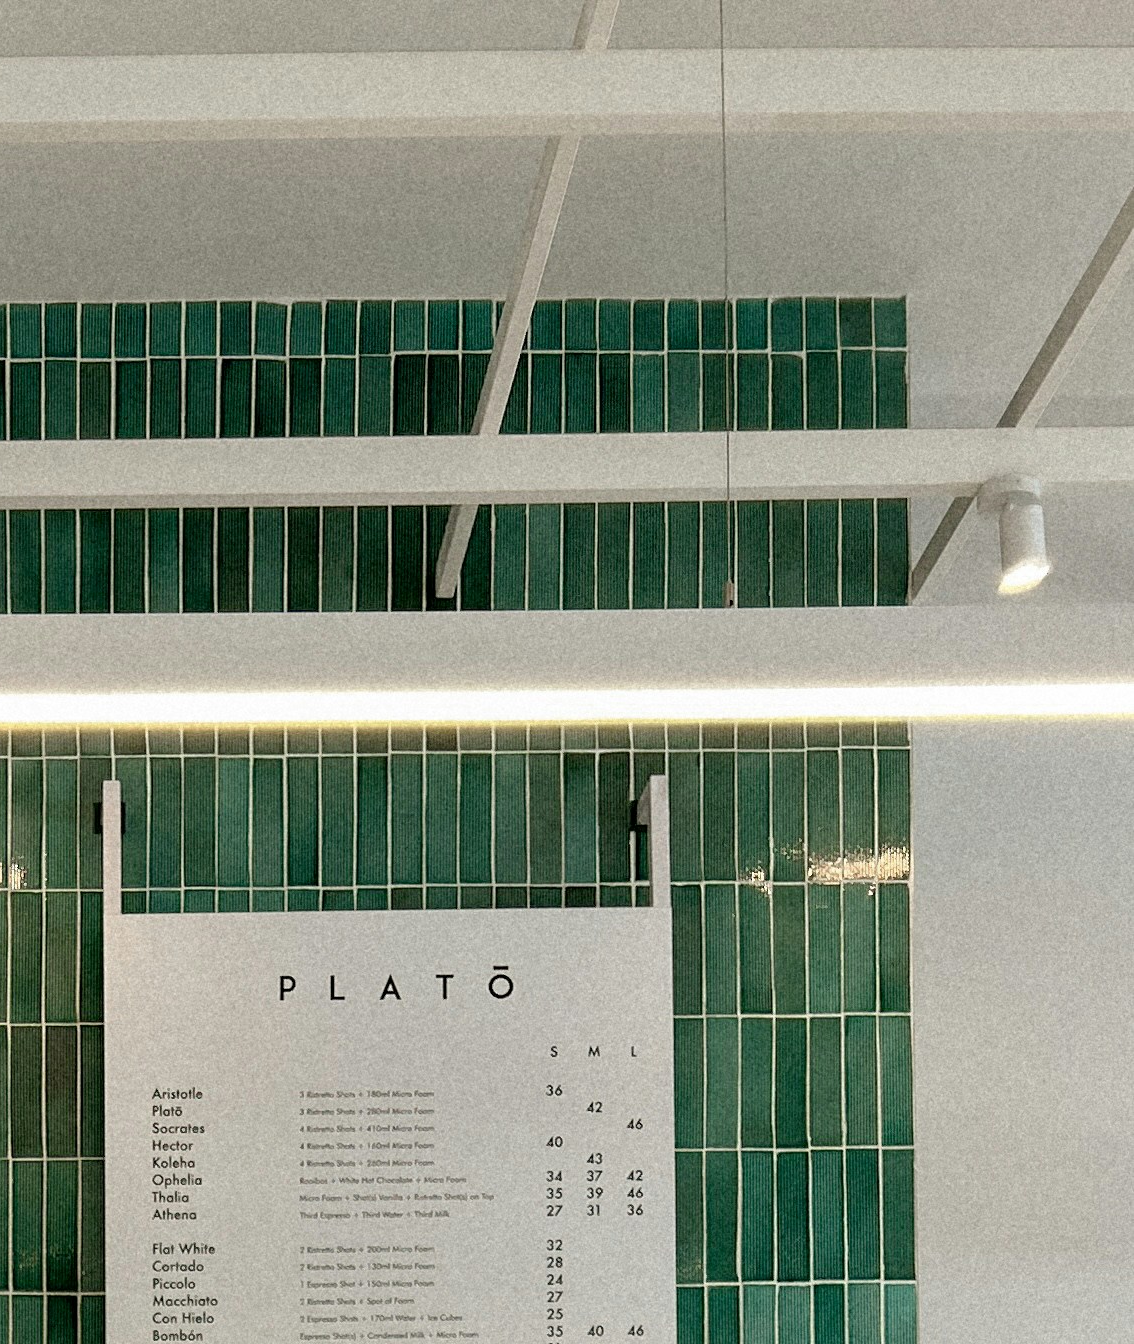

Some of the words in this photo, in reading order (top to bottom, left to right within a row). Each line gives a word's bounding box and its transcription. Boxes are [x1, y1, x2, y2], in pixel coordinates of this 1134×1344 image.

[550, 1045, 559, 1058] S
[588, 1046, 600, 1056] M
[630, 1045, 637, 1057] L
[152, 1087, 202, 1099] Aristotle
[546, 1085, 563, 1096] 36
[587, 1102, 602, 1113] 42
[153, 1122, 205, 1134] Socrates
[627, 1119, 643, 1130] 46
[152, 1140, 193, 1151] Hector
[547, 1136, 563, 1147] 40
[587, 1153, 602, 1164] 43
[152, 1174, 202, 1188] Ophelia
[547, 1171, 562, 1182] 34
[587, 1170, 603, 1181] 37
[627, 1170, 643, 1181] 42
[152, 1191, 189, 1202] Thalia
[547, 1188, 562, 1199] 35
[587, 1187, 603, 1199] 39
[627, 1188, 643, 1198] 46
[153, 1209, 196, 1220] Athena
[547, 1205, 563, 1216] 27
[587, 1205, 600, 1216] 31
[628, 1204, 643, 1215] 36
[153, 1243, 174, 1254] Flat
[179, 1243, 215, 1254] White
[547, 1239, 562, 1251] 32
[152, 1260, 204, 1272] Cortado
[547, 1257, 563, 1268] 28
[153, 1277, 195, 1289] Piccolo
[547, 1274, 563, 1285] 24
[153, 1295, 218, 1306] Macchiato
[547, 1291, 563, 1302] 27
[152, 1312, 177, 1324] Con
[183, 1312, 214, 1323] Hielo
[547, 1308, 563, 1320] 25
[153, 1330, 202, 1341] Bombón
[547, 1326, 563, 1337] 35
[588, 1325, 604, 1336] 40
[628, 1325, 644, 1336] 46
